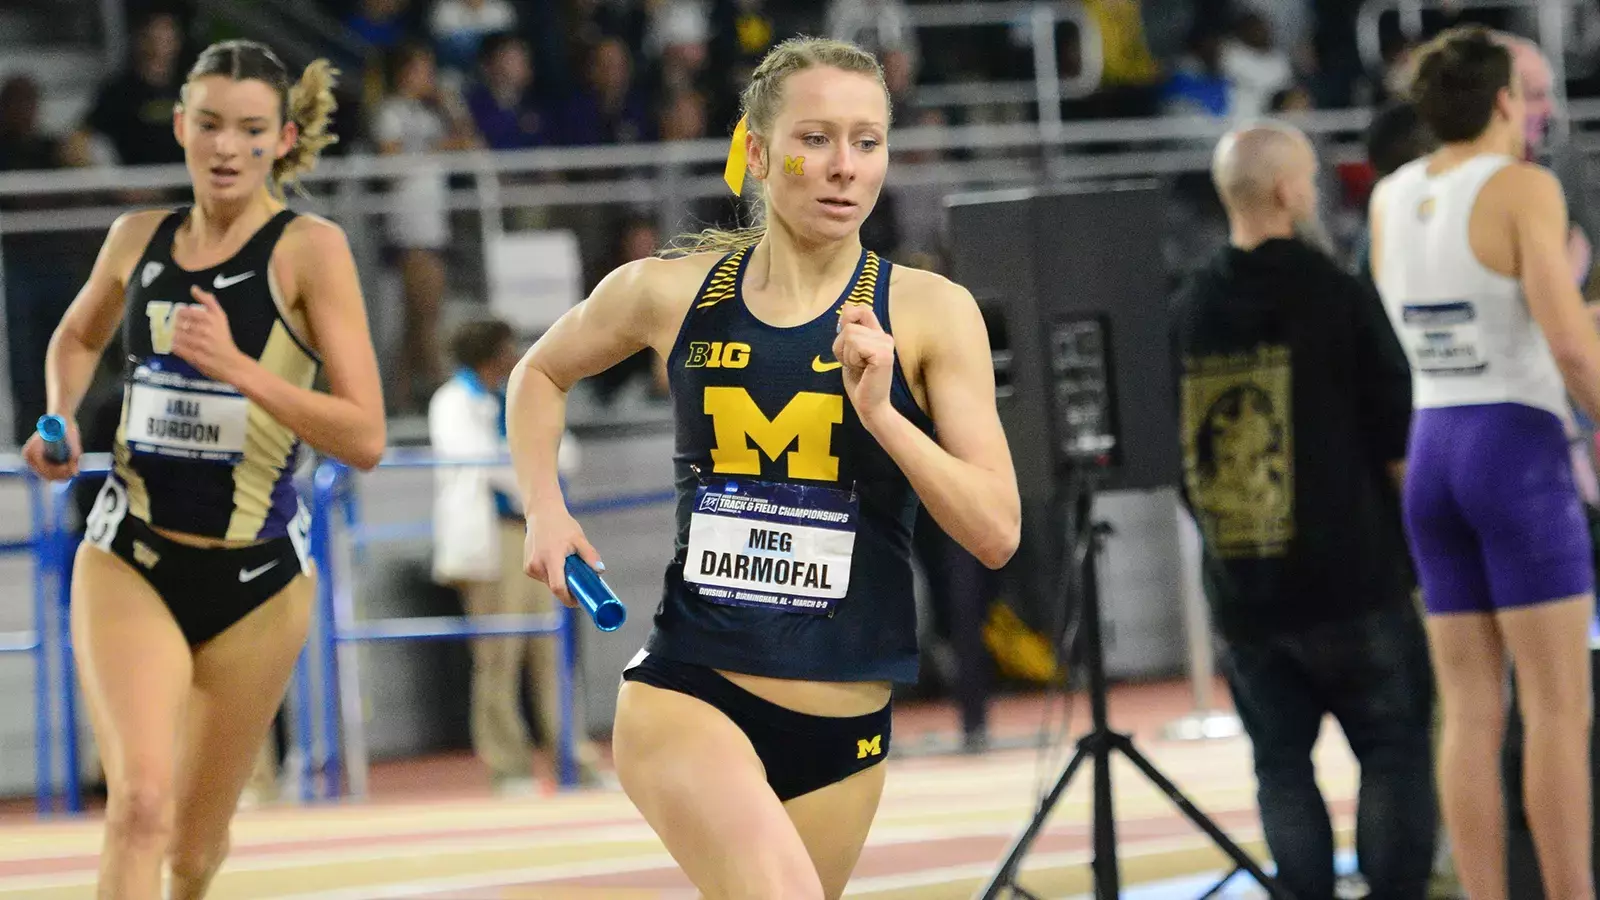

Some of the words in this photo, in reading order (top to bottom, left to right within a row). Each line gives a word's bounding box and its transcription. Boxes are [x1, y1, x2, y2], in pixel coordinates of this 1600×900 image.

[703, 386, 843, 481] M
[719, 498, 748, 511] TRACK
[747, 502, 754, 512] &
[754, 503, 778, 514] FIELD
[778, 506, 849, 523] CHAMPIONSHIPS
[748, 528, 793, 553] MEG
[700, 550, 832, 590] DARMOFAL
[699, 587, 727, 598] DIVISION
[735, 591, 778, 604] BIRMINGHAM,
[779, 597, 788, 605] AL
[792, 598, 816, 608] MARCH
[857, 734, 881, 759] M
